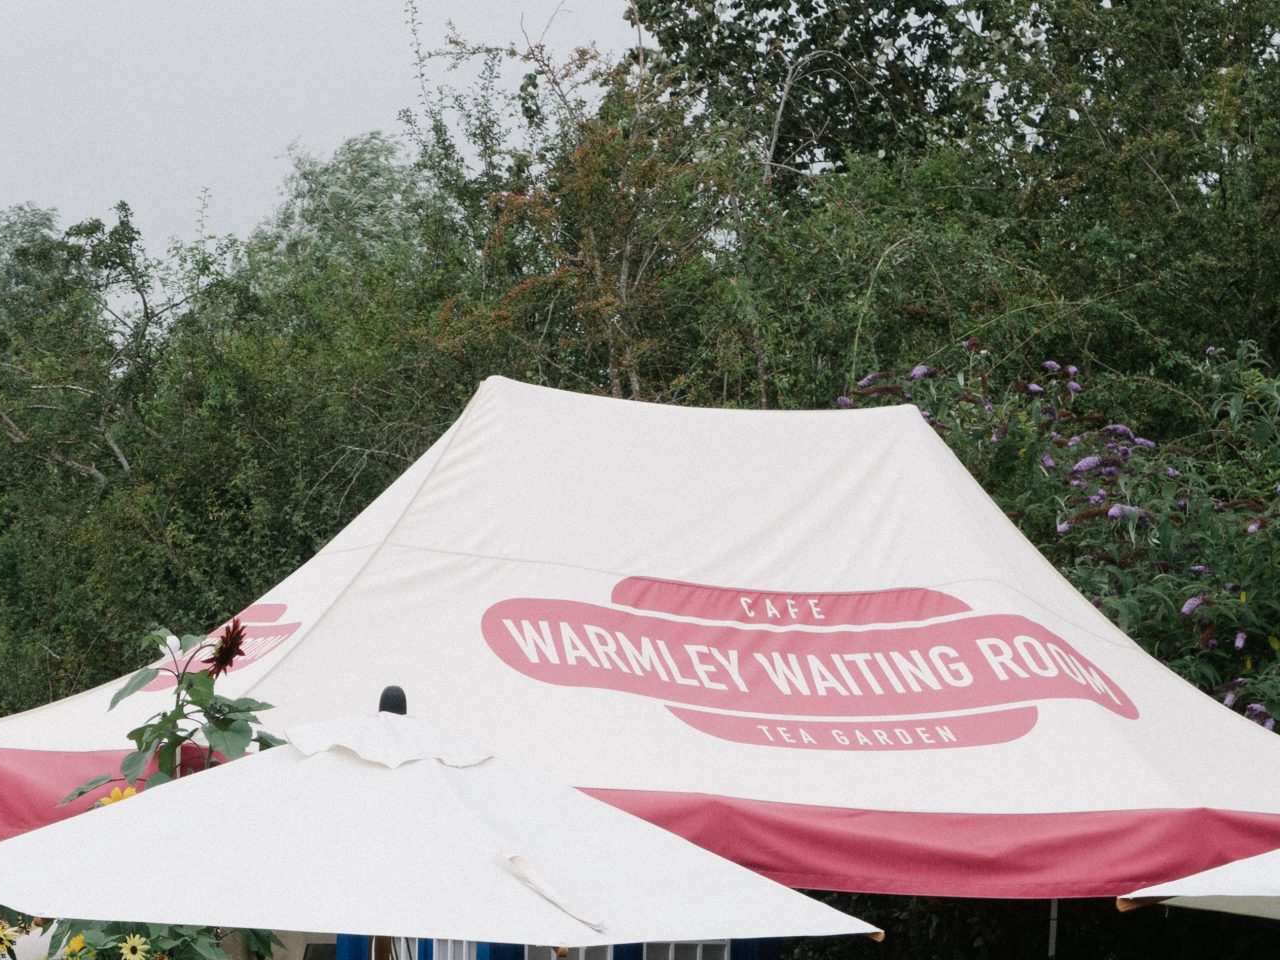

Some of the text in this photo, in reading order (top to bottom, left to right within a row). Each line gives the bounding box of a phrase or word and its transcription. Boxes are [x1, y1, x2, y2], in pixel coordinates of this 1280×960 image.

[740, 597, 825, 619] CAFE
[502, 619, 1123, 705] WARMLEY WAITING ROOM
[757, 725, 957, 745] TEA GARDEN
